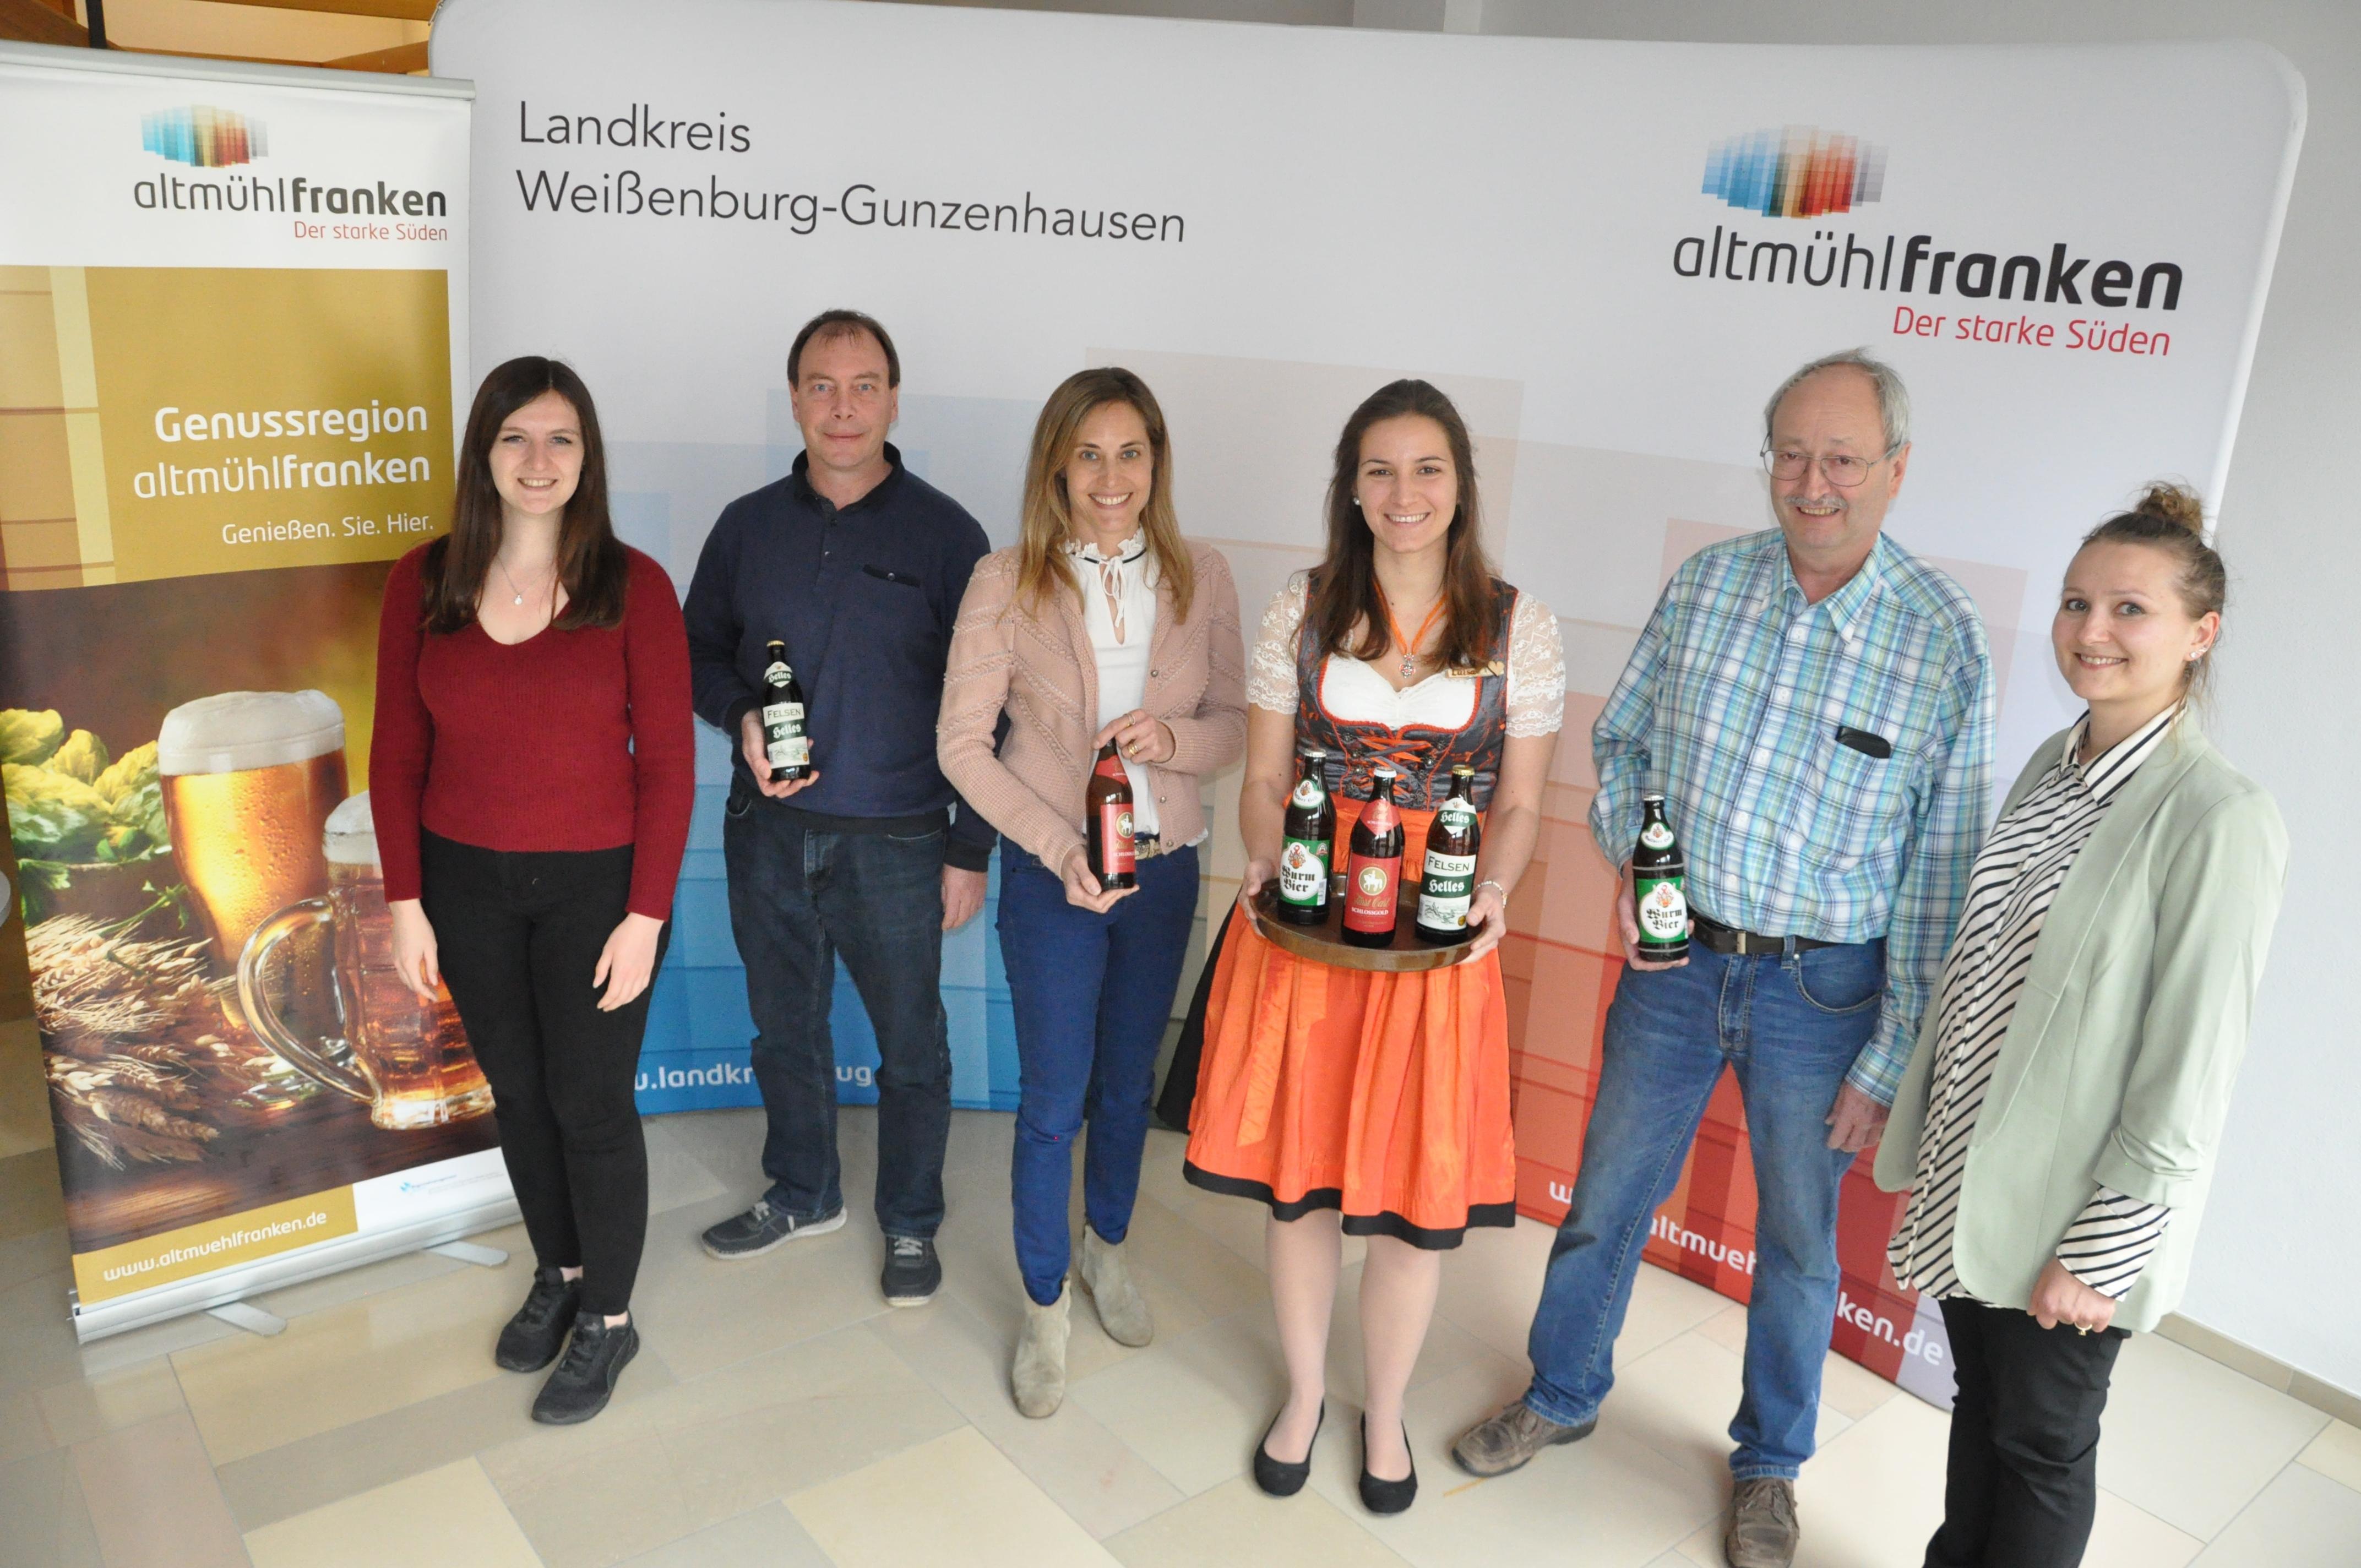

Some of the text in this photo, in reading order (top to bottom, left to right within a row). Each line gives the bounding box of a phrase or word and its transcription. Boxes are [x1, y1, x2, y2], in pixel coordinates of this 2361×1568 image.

[520, 100, 751, 153] Landkreis
[134, 172, 447, 217] altmühlfranken
[515, 169, 1184, 242] Weißenburg-Gunzenhausen
[295, 221, 447, 242] Der starke Süden
[1673, 225, 2183, 310] altmühlfranken
[1892, 306, 2170, 356] Der starke Süden
[154, 399, 427, 443] Genussregion
[134, 451, 430, 499] altmühlfranken
[222, 514, 433, 545] Genießen. Sie. Hier.
[768, 708, 802, 719] FELSEN
[773, 723, 802, 739] Helles
[1440, 812, 1470, 824] Helles
[1428, 855, 1470, 872] FELSEN
[1284, 877, 1309, 892] Bier
[1429, 879, 1465, 893] Helles
[1351, 907, 1389, 916] SCHLOSSGOLD
[102, 1210, 328, 1282] www.altmuehlfranken.de
